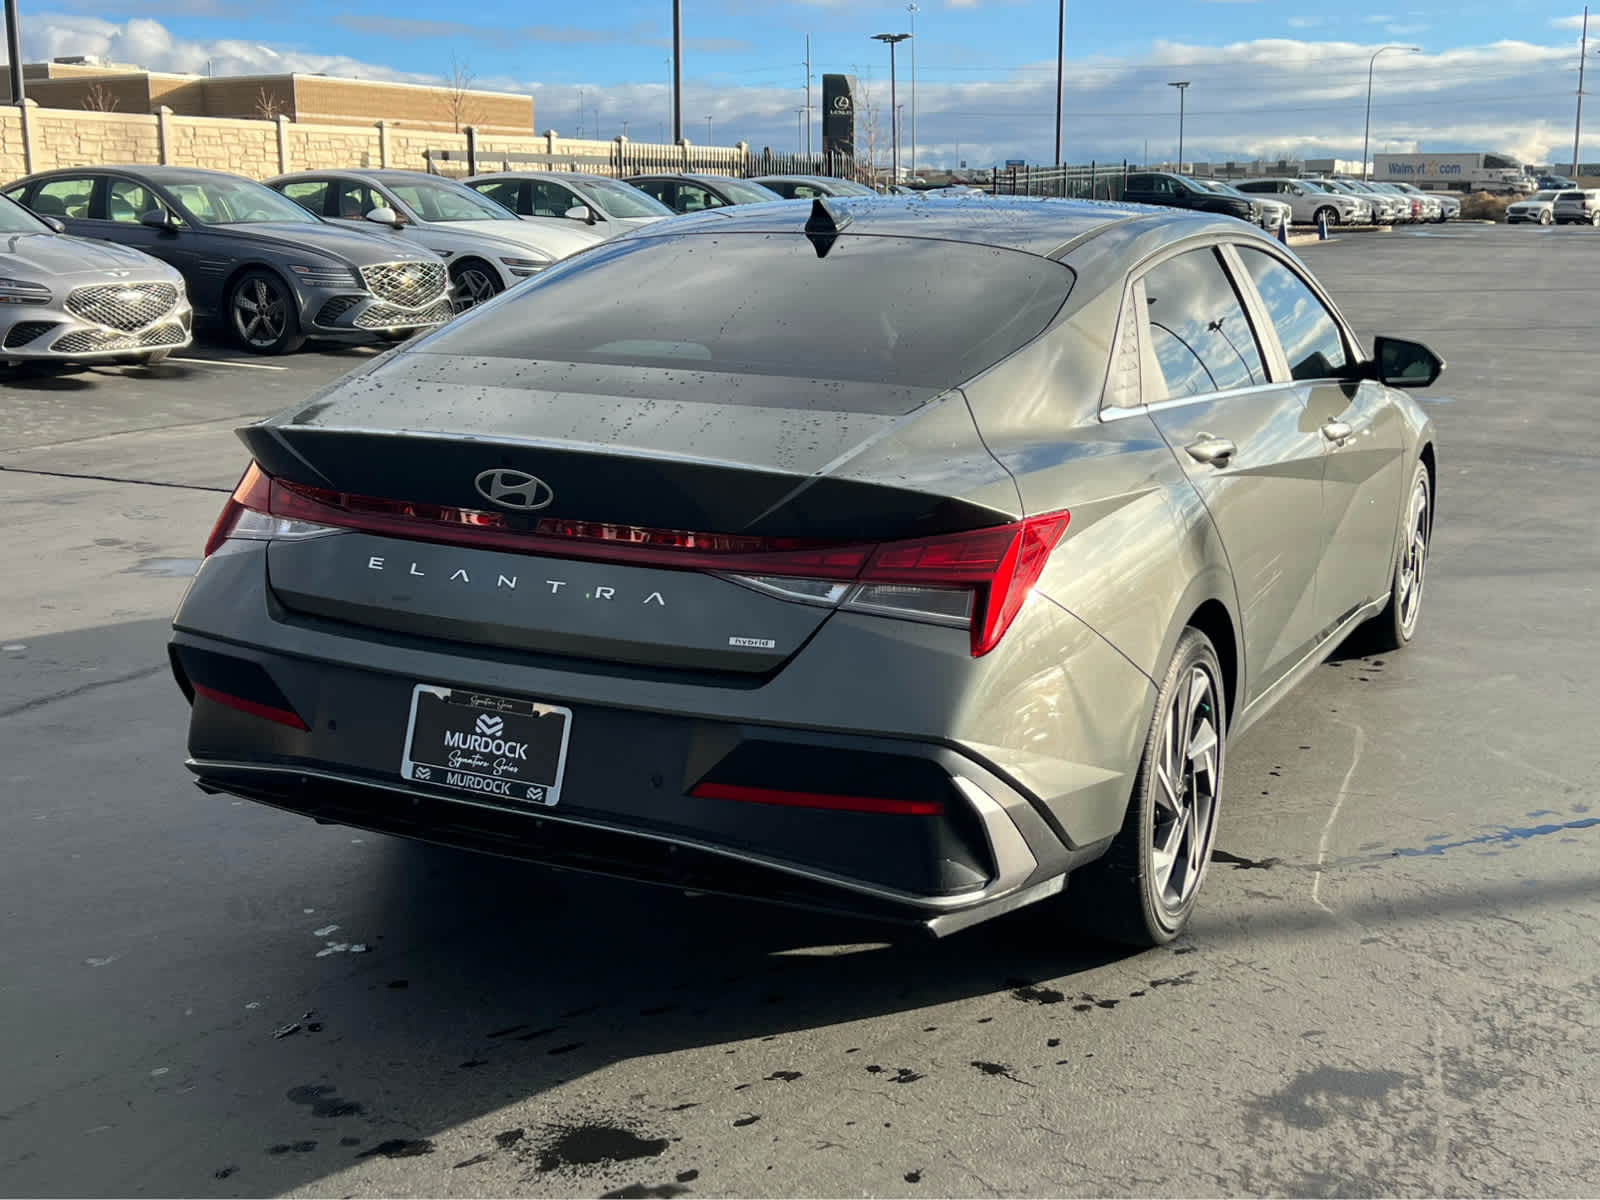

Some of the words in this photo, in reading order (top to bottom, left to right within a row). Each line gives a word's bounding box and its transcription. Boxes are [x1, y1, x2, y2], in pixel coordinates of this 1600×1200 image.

[368, 556, 665, 606] ELANTRA
[444, 730, 529, 760] MURDOCK
[446, 772, 512, 795] MURDOCK
